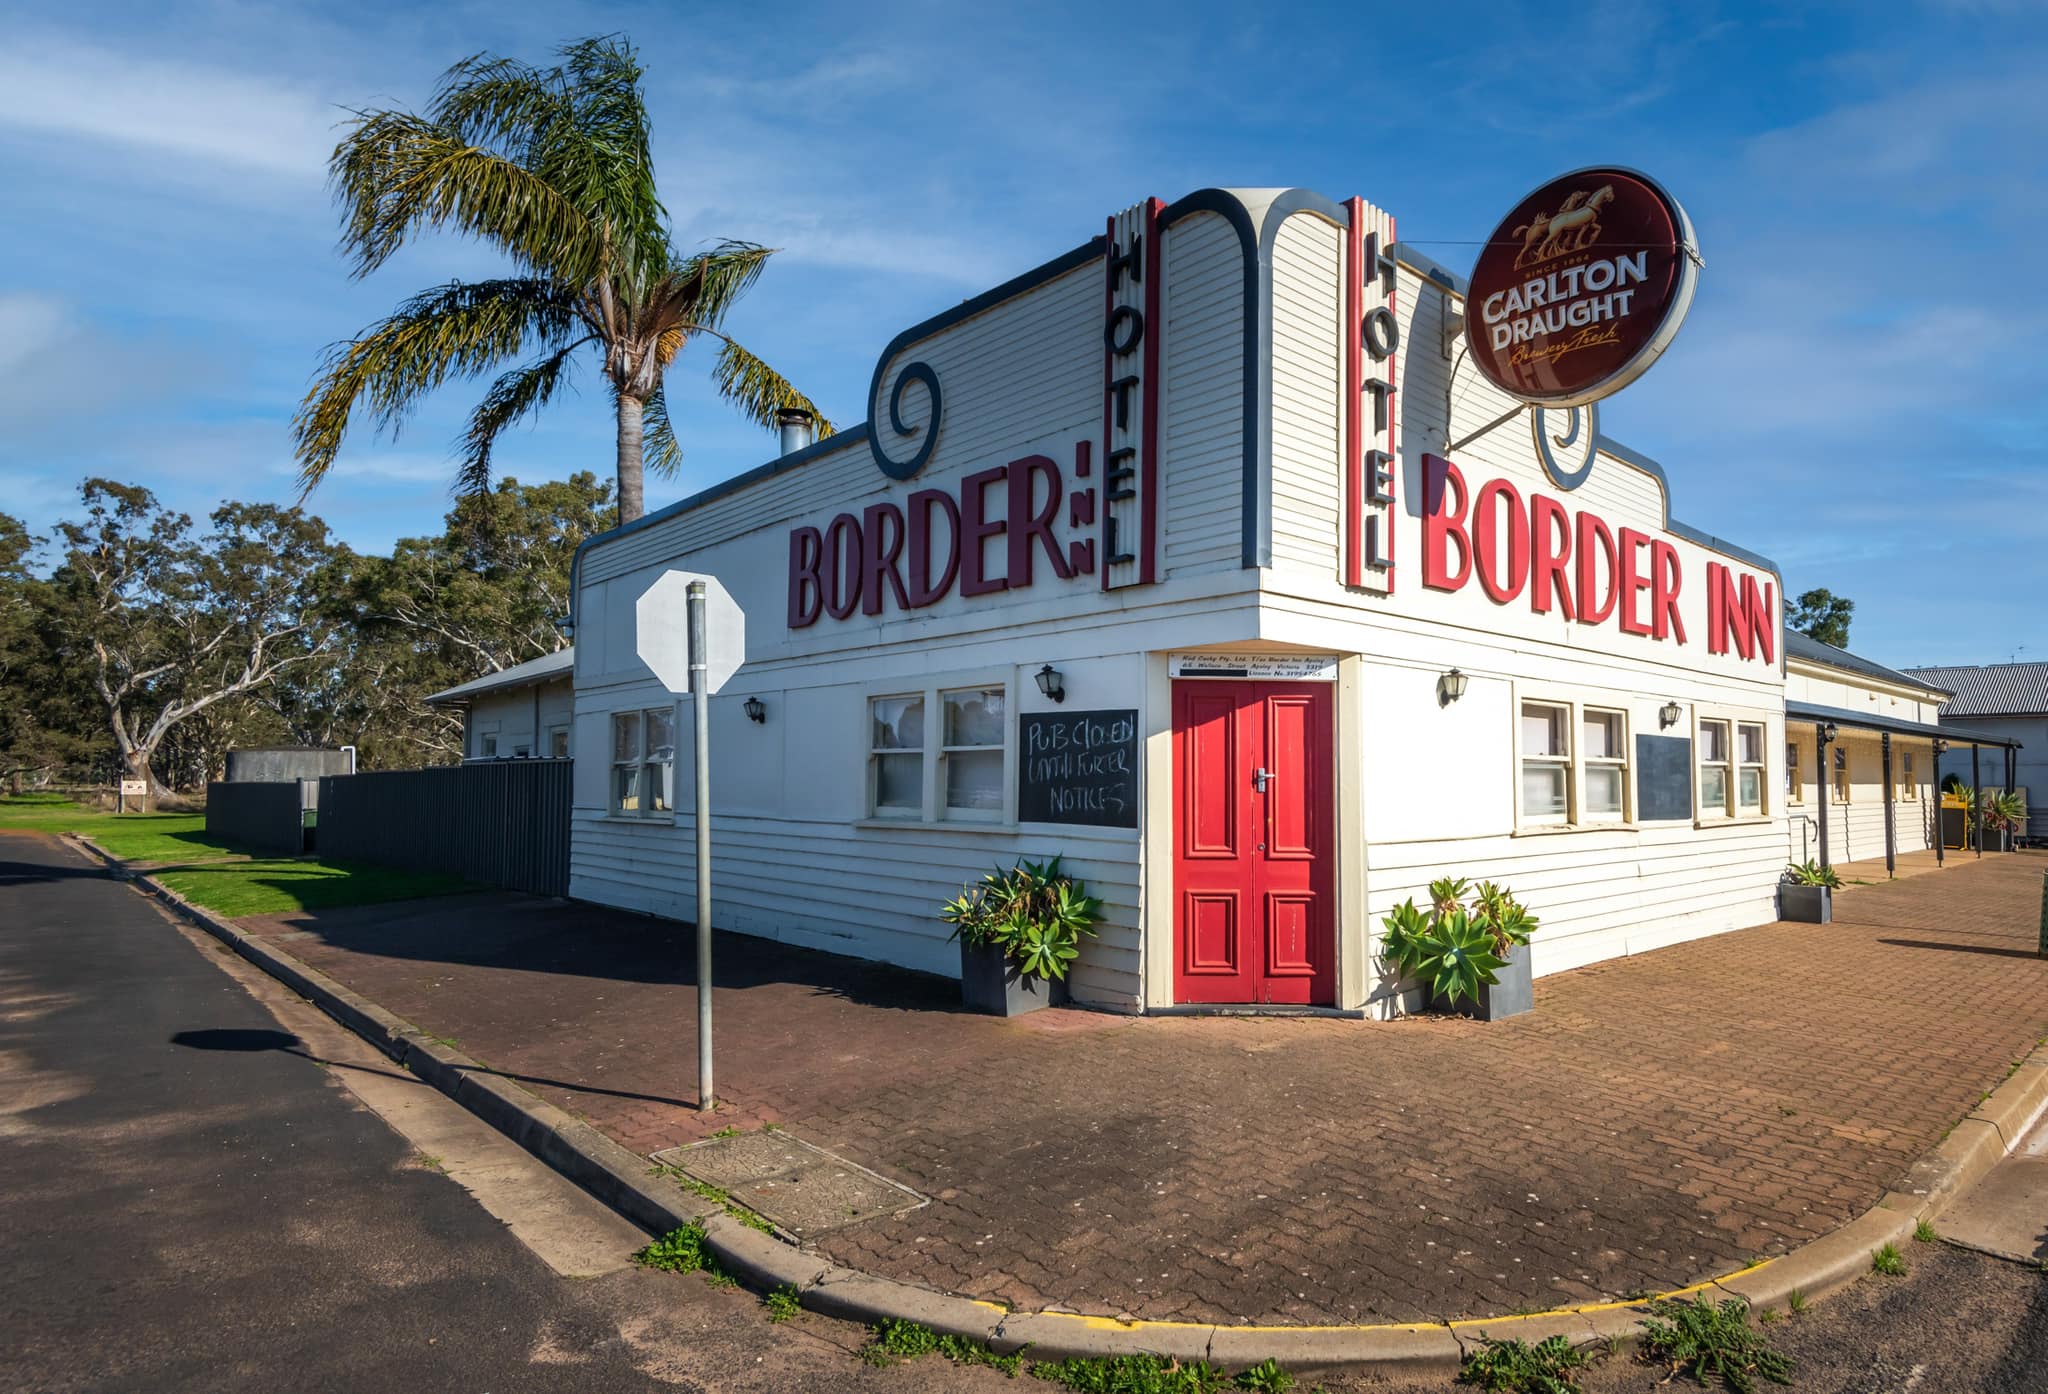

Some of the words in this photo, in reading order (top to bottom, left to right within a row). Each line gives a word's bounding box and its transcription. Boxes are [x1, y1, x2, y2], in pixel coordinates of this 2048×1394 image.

[1482, 250, 1648, 325] CARLTON
[1492, 289, 1635, 352] DRAUGHT
[1508, 341, 1571, 367] Brewery
[1572, 322, 1621, 348] Fresh
[1104, 230, 1143, 566] HOTEL
[1362, 230, 1399, 570] HOTEL
[788, 454, 1075, 629] BORDER
[1070, 440, 1095, 576] INN
[1421, 453, 1688, 646] BORDER
[1706, 561, 1775, 665] INN
[1029, 722, 1069, 756] PUB
